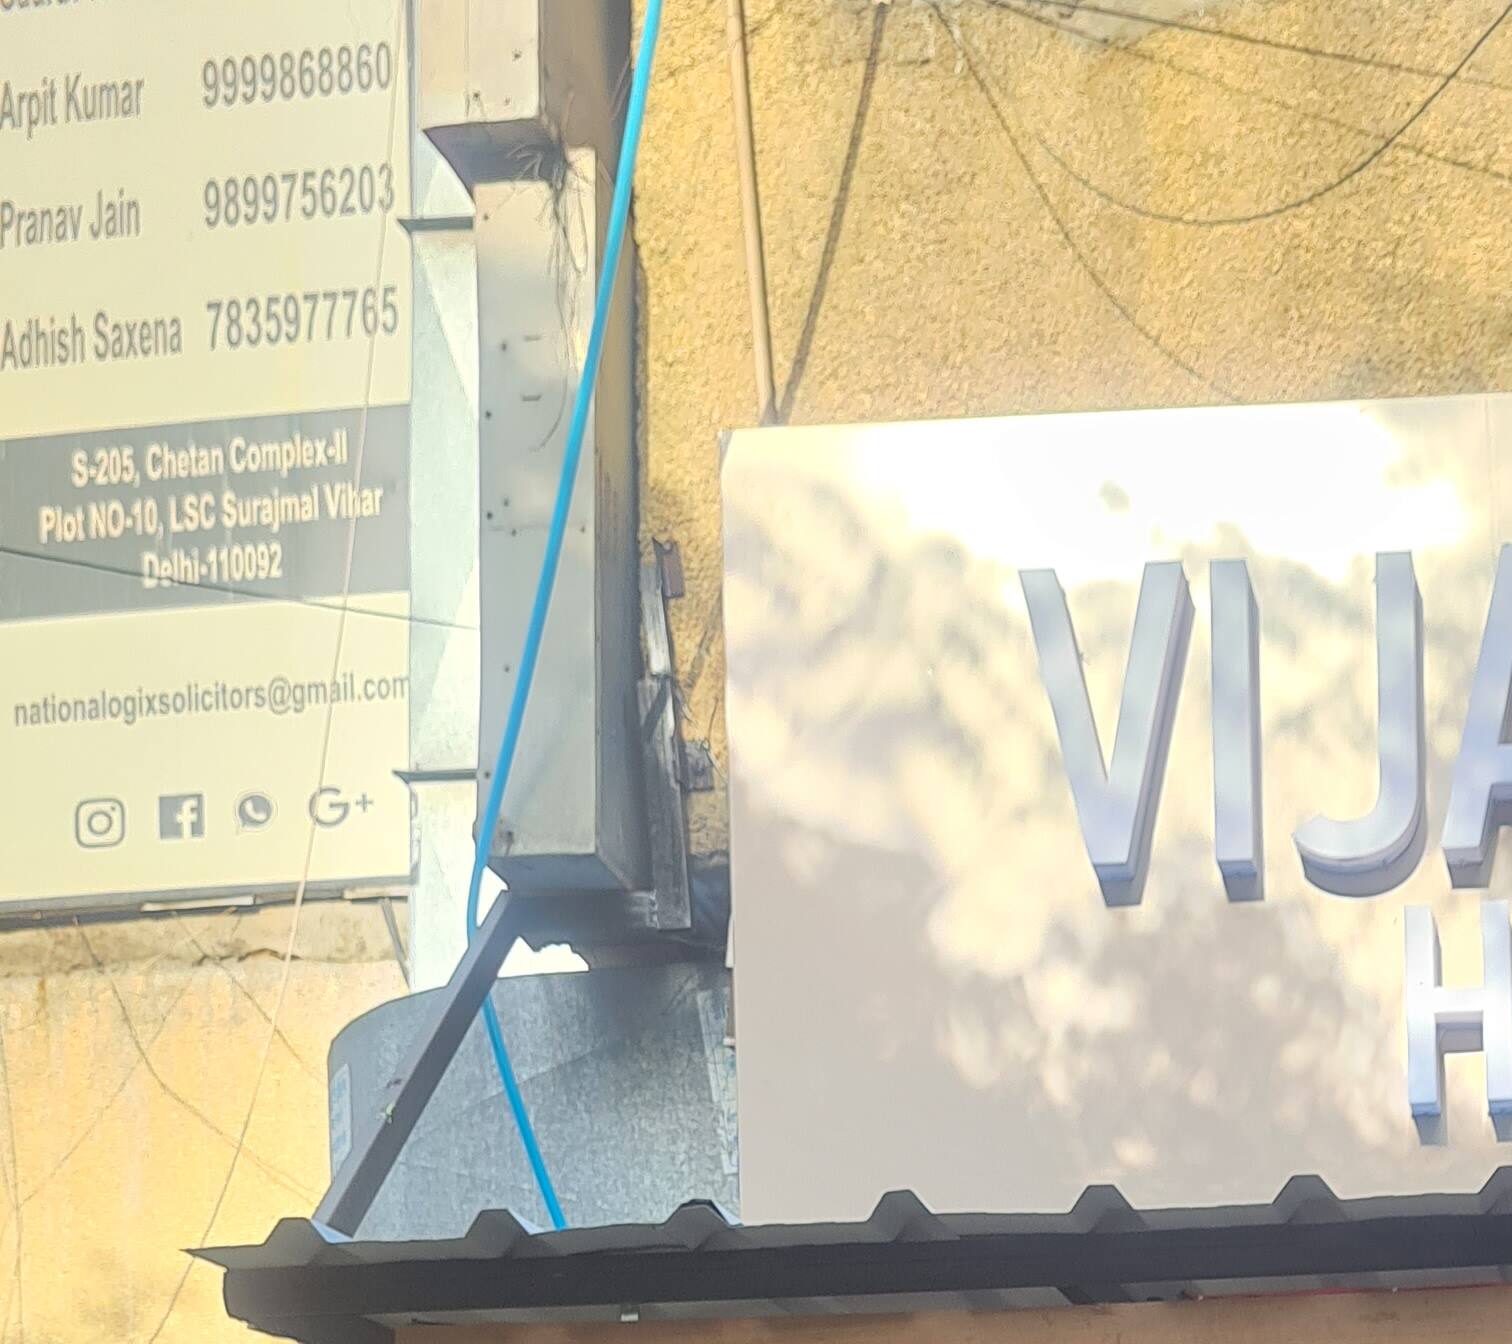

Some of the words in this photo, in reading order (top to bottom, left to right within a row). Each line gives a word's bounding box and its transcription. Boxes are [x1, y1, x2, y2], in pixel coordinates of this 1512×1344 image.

[0, 77, 57, 139] Arpit
[64, 72, 145, 122] Kumar
[202, 41, 391, 108] 9999868860
[0, 199, 82, 248] Pranav
[90, 187, 140, 240] Jain
[203, 163, 395, 229] 9899756203
[0, 312, 85, 371] Adhish
[94, 311, 183, 362] Saxena
[206, 287, 398, 351] 7835977765
[71, 447, 140, 488] S-205,
[145, 441, 223, 482] Chetan
[229, 428, 348, 478] Complex-II
[39, 505, 84, 544] Plot
[88, 499, 163, 541] NO-10,
[169, 492, 215, 533] LSC
[222, 484, 318, 532] Surajmal
[323, 481, 383, 520] Vihar
[142, 543, 283, 588] Delhi-110092
